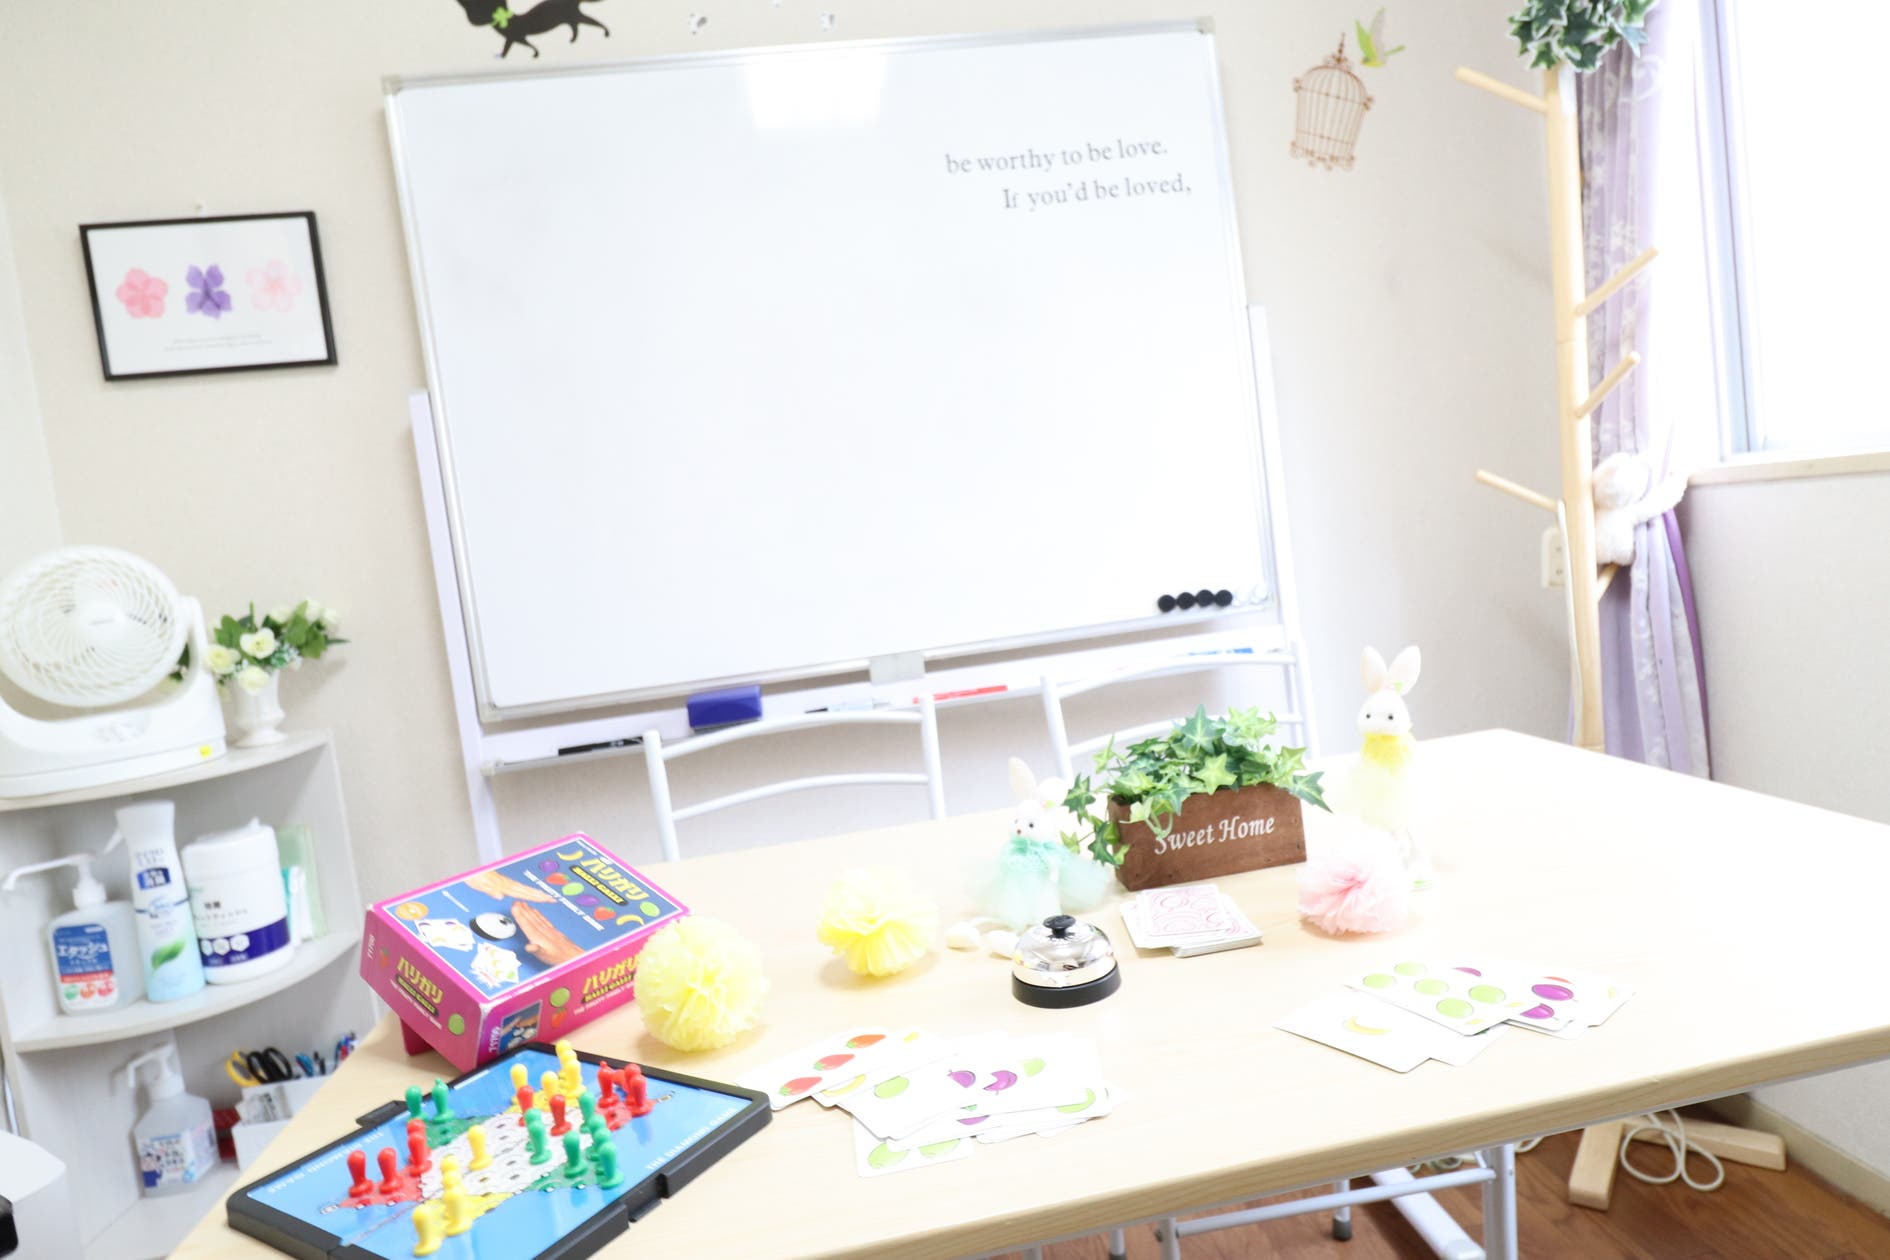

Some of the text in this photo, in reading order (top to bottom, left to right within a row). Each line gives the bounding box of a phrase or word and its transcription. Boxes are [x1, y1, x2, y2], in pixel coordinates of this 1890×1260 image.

[945, 138, 1168, 174] be worthy to be love.
[1003, 172, 1192, 212] If you'd be loved,
[1154, 816, 1275, 855] Sweet Home
[580, 858, 650, 901] ハリガリ
[397, 956, 443, 1004] ハリガリ
